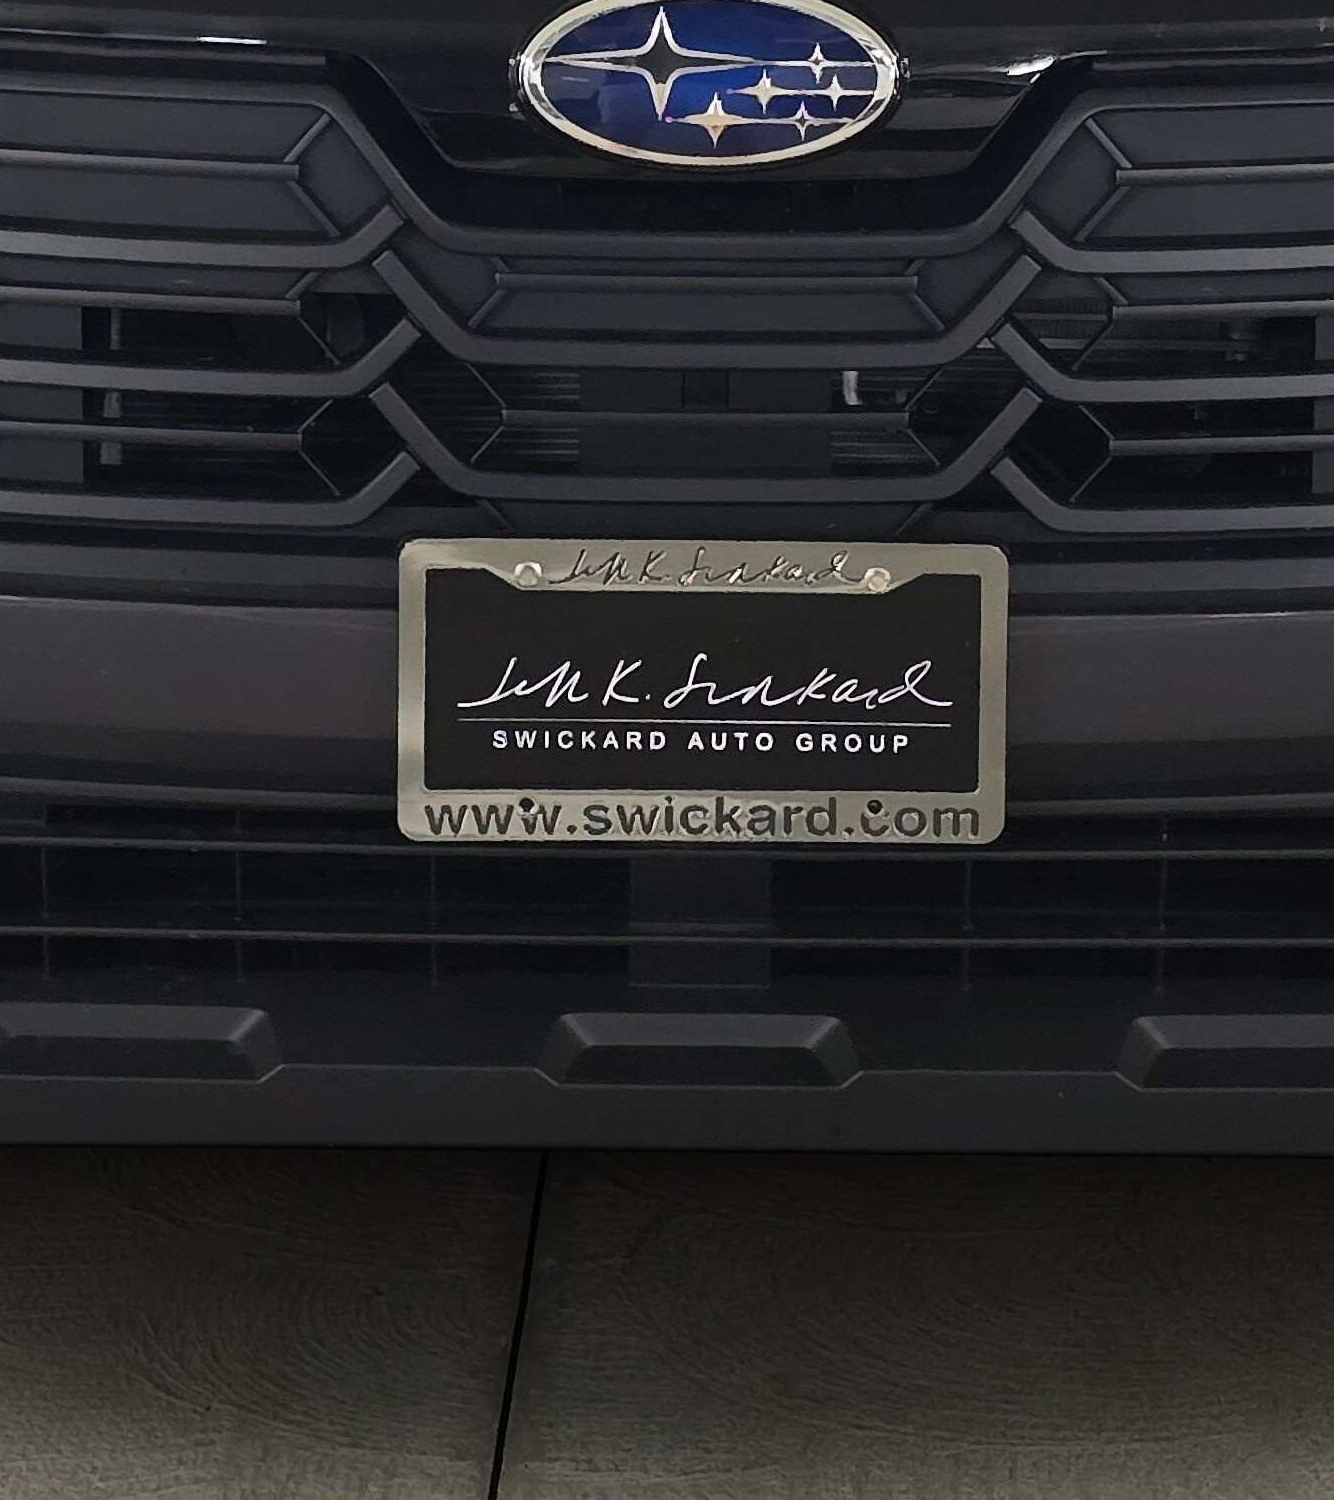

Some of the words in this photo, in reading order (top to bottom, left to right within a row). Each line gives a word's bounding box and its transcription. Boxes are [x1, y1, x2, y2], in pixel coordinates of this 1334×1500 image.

[492, 729, 667, 751] SWICKARD
[687, 731, 774, 752] AUTO
[795, 732, 909, 754] GROUP
[425, 796, 980, 838] www.swickard.com
